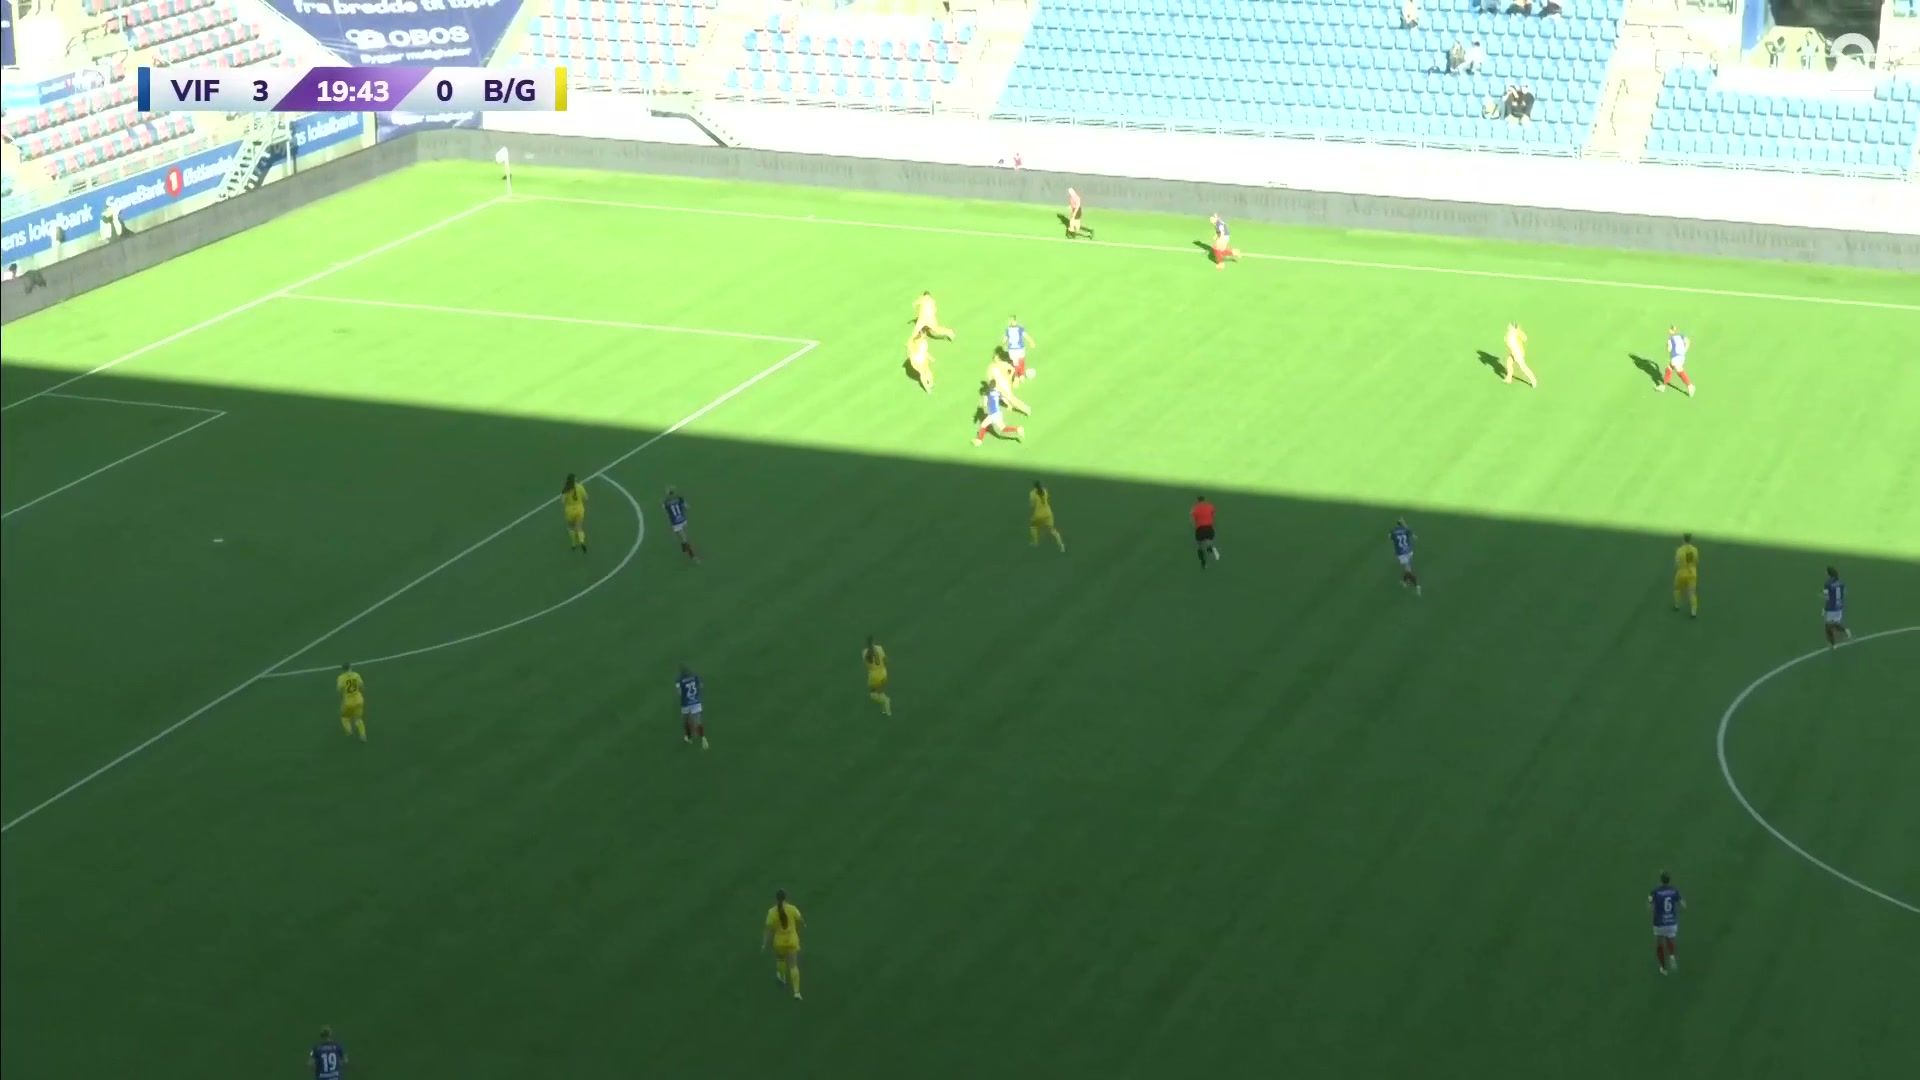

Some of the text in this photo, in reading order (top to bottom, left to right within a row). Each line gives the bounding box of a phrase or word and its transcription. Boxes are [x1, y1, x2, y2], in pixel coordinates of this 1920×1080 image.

[388, 26, 470, 48] OBOS
[28, 203, 94, 242] lokalbank
[105, 178, 166, 211] SpareBank
[670, 503, 682, 516] 11
[684, 681, 697, 699] 23
[1663, 896, 1673, 912] 6
[321, 1052, 337, 1073] 19
